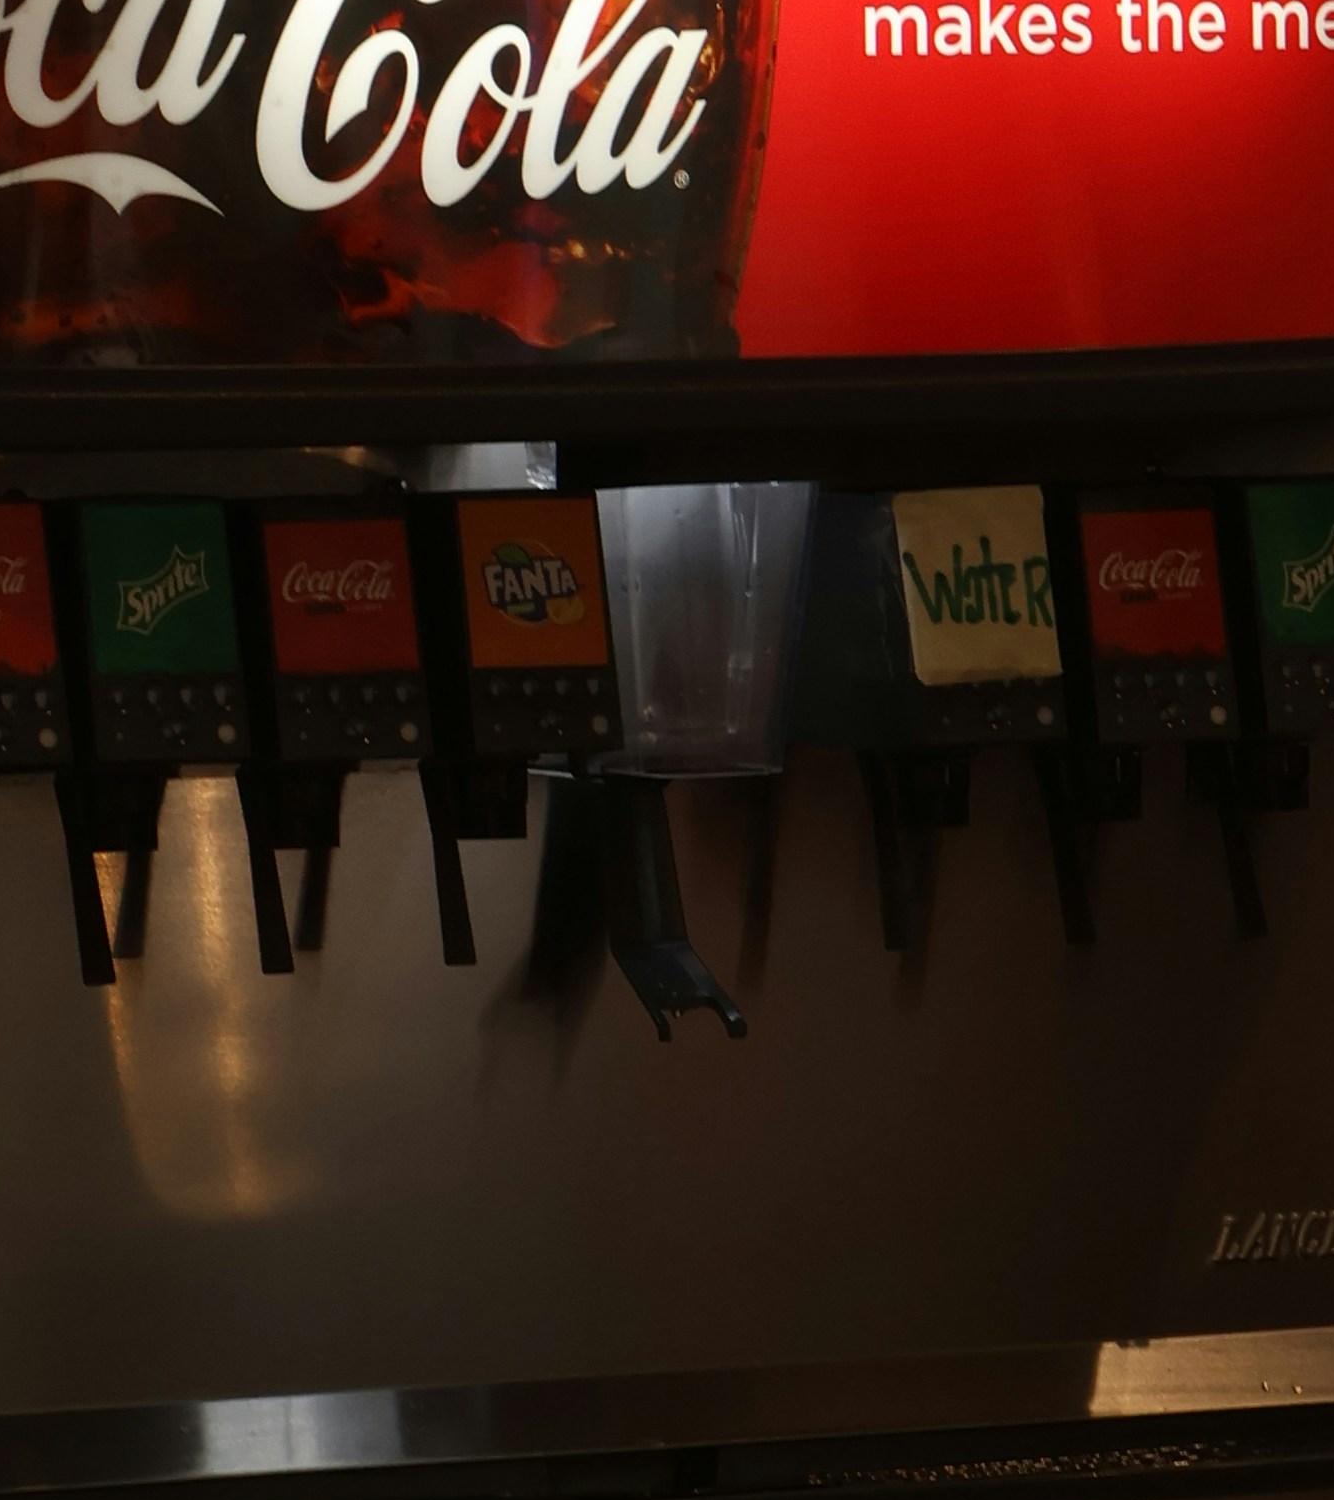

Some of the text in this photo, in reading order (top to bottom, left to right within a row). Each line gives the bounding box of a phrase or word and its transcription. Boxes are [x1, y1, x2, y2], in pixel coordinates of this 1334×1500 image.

[125, 557, 199, 626] Sprite
[282, 558, 395, 603] Coca-Cola
[483, 557, 578, 606] FANTA
[1099, 548, 1203, 593] Coca-Cola
